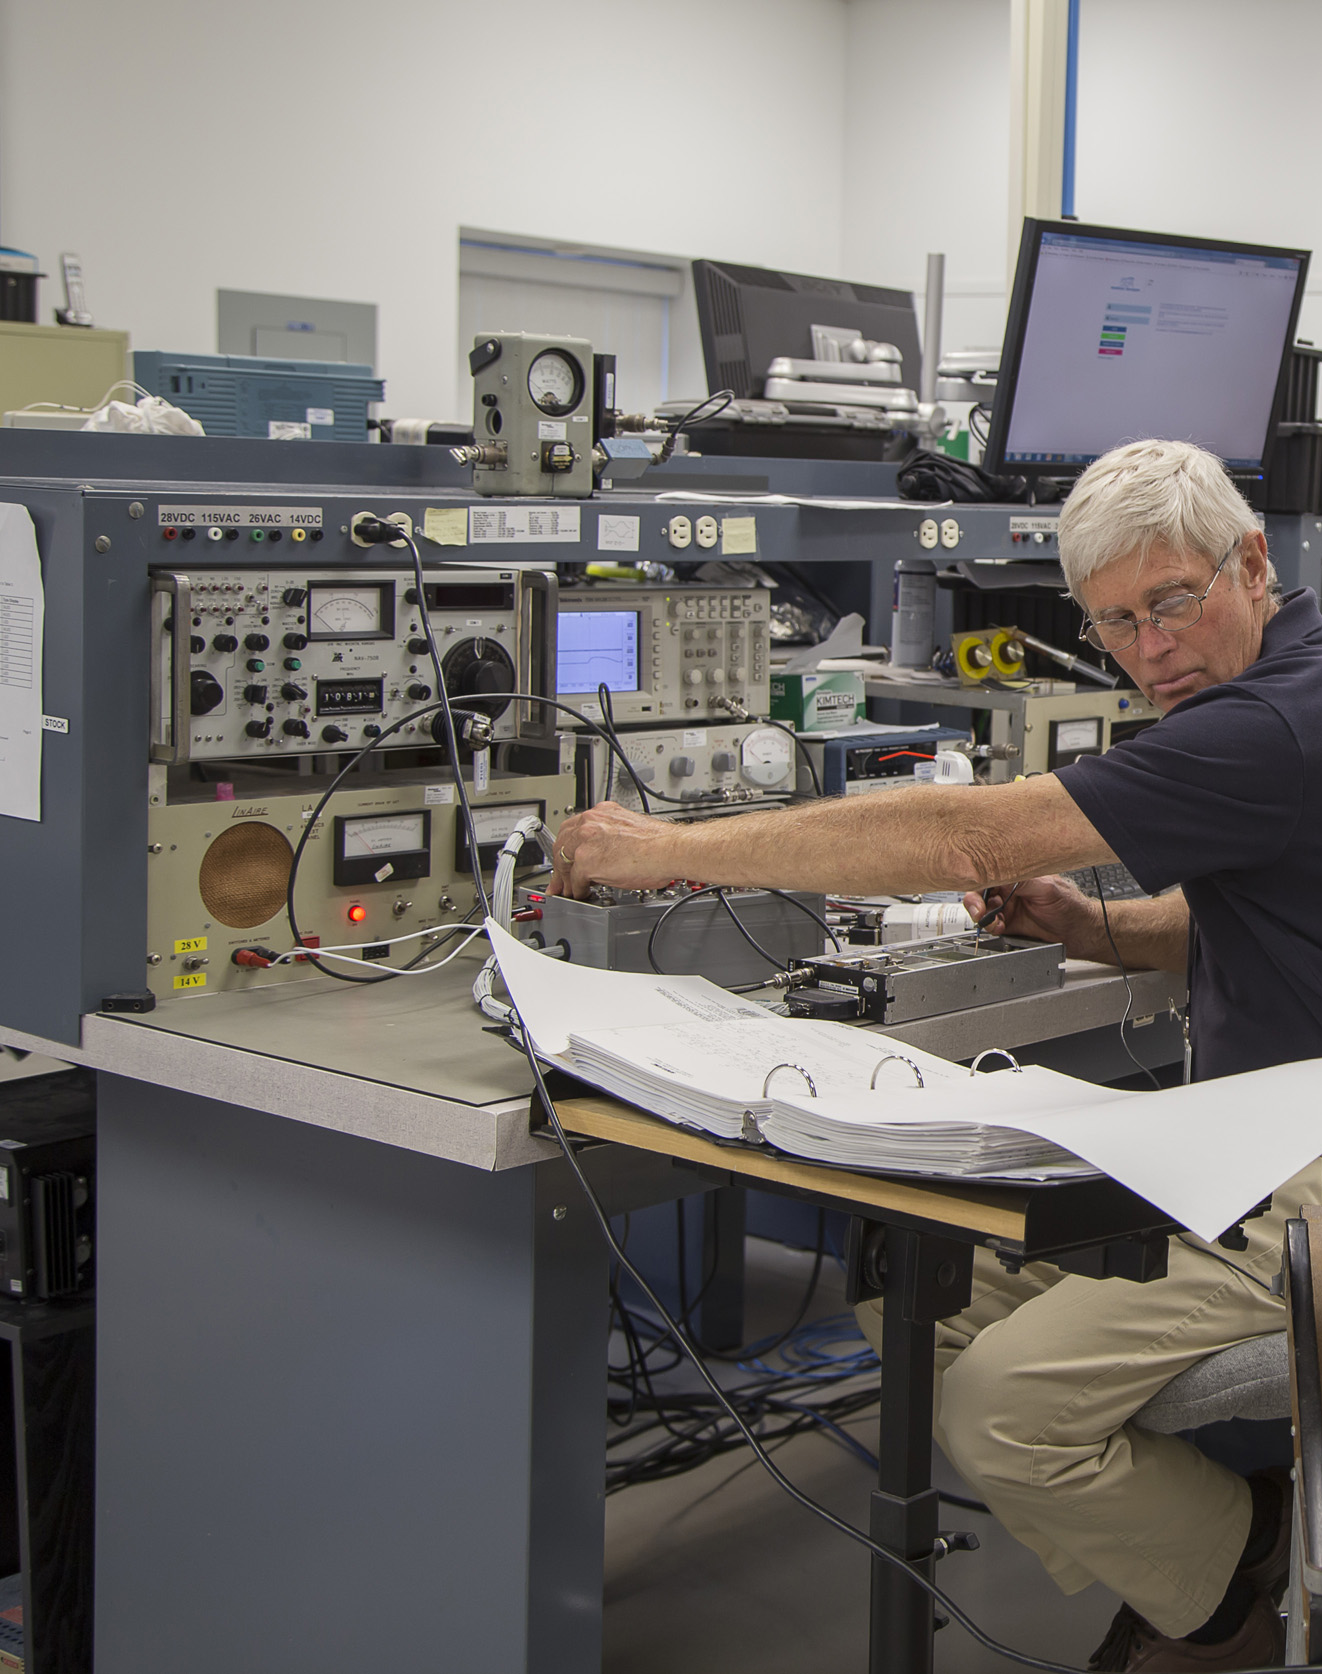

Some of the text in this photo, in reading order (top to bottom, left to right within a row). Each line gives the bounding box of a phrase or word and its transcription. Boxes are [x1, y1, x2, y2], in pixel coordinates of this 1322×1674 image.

[161, 512, 321, 524] 28VDC 115VAC 26VAC 14VDC
[816, 694, 854, 705] KIMTECH
[45, 718, 65, 730] STOCK
[181, 940, 201, 951] 28 V
[180, 976, 200, 987] 14 V
